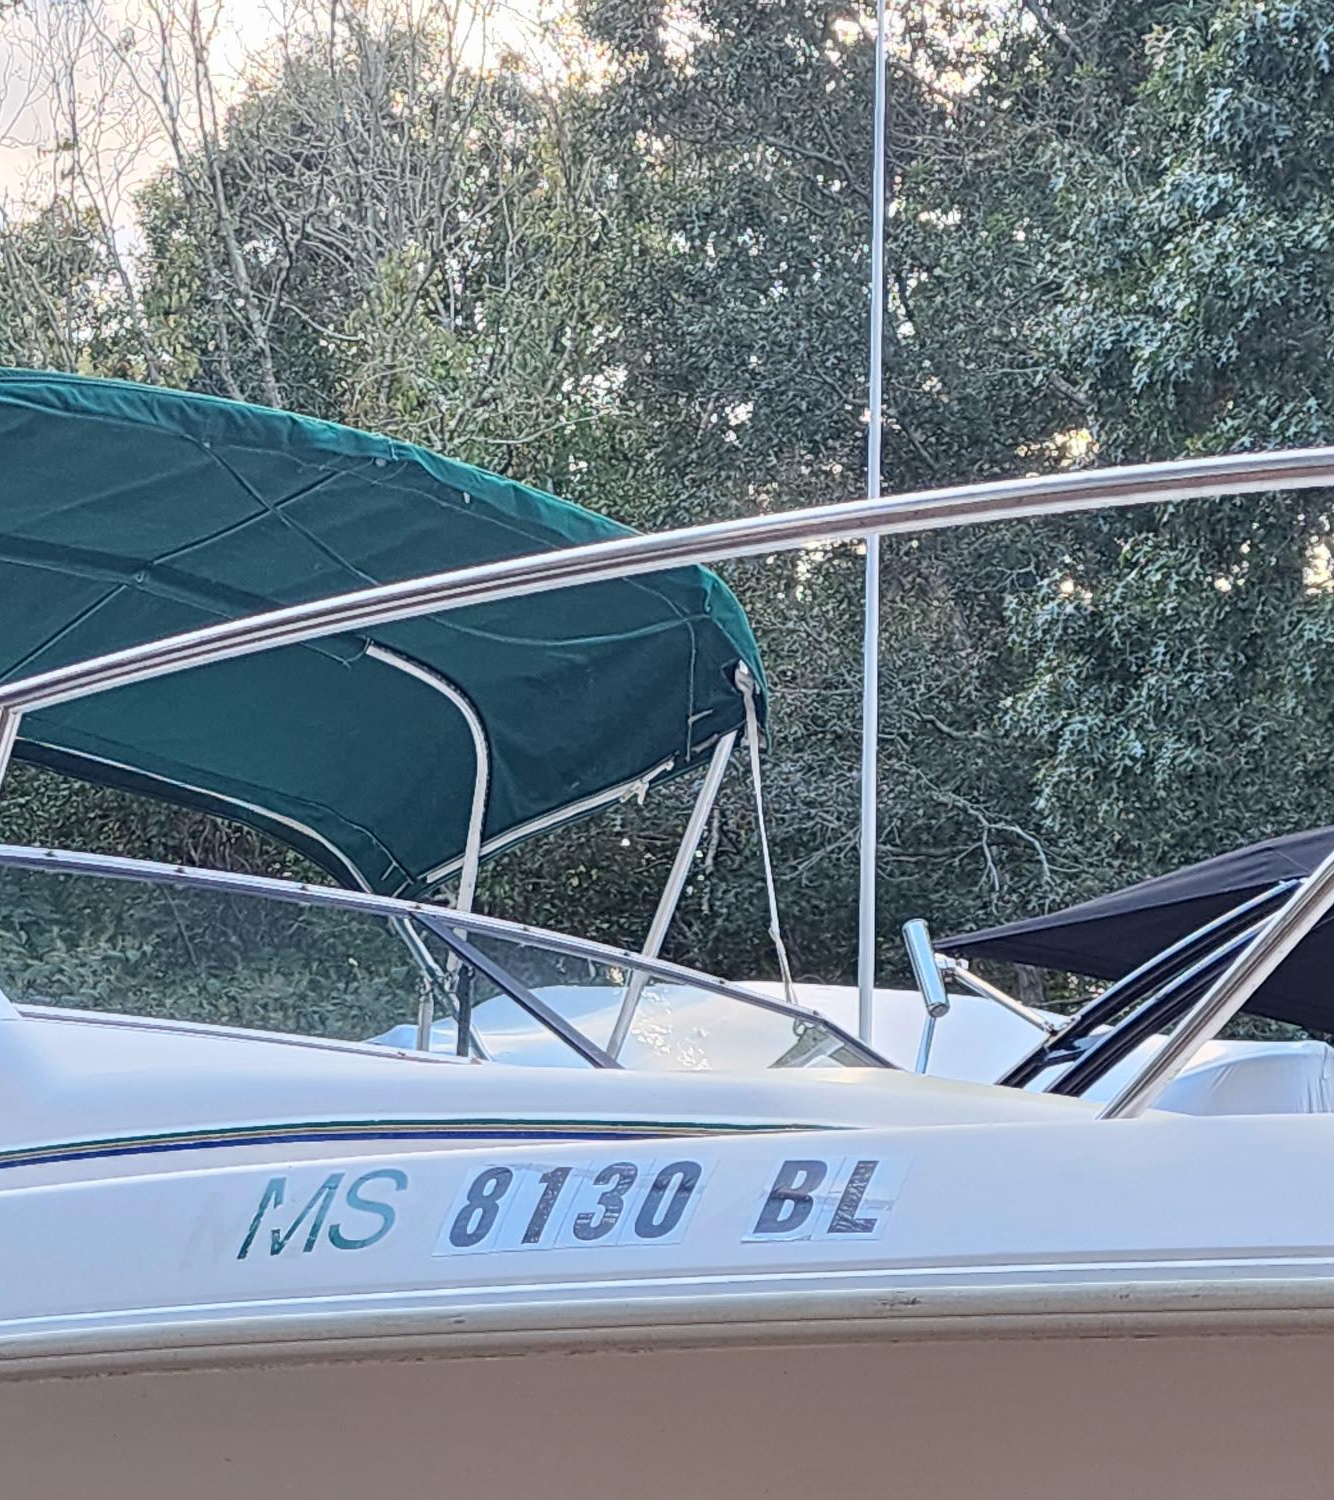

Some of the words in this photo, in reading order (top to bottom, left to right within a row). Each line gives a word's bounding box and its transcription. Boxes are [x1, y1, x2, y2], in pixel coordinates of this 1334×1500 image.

[235, 1167, 410, 1261] MS
[447, 1160, 704, 1249] 8130
[752, 1158, 881, 1236] BL
